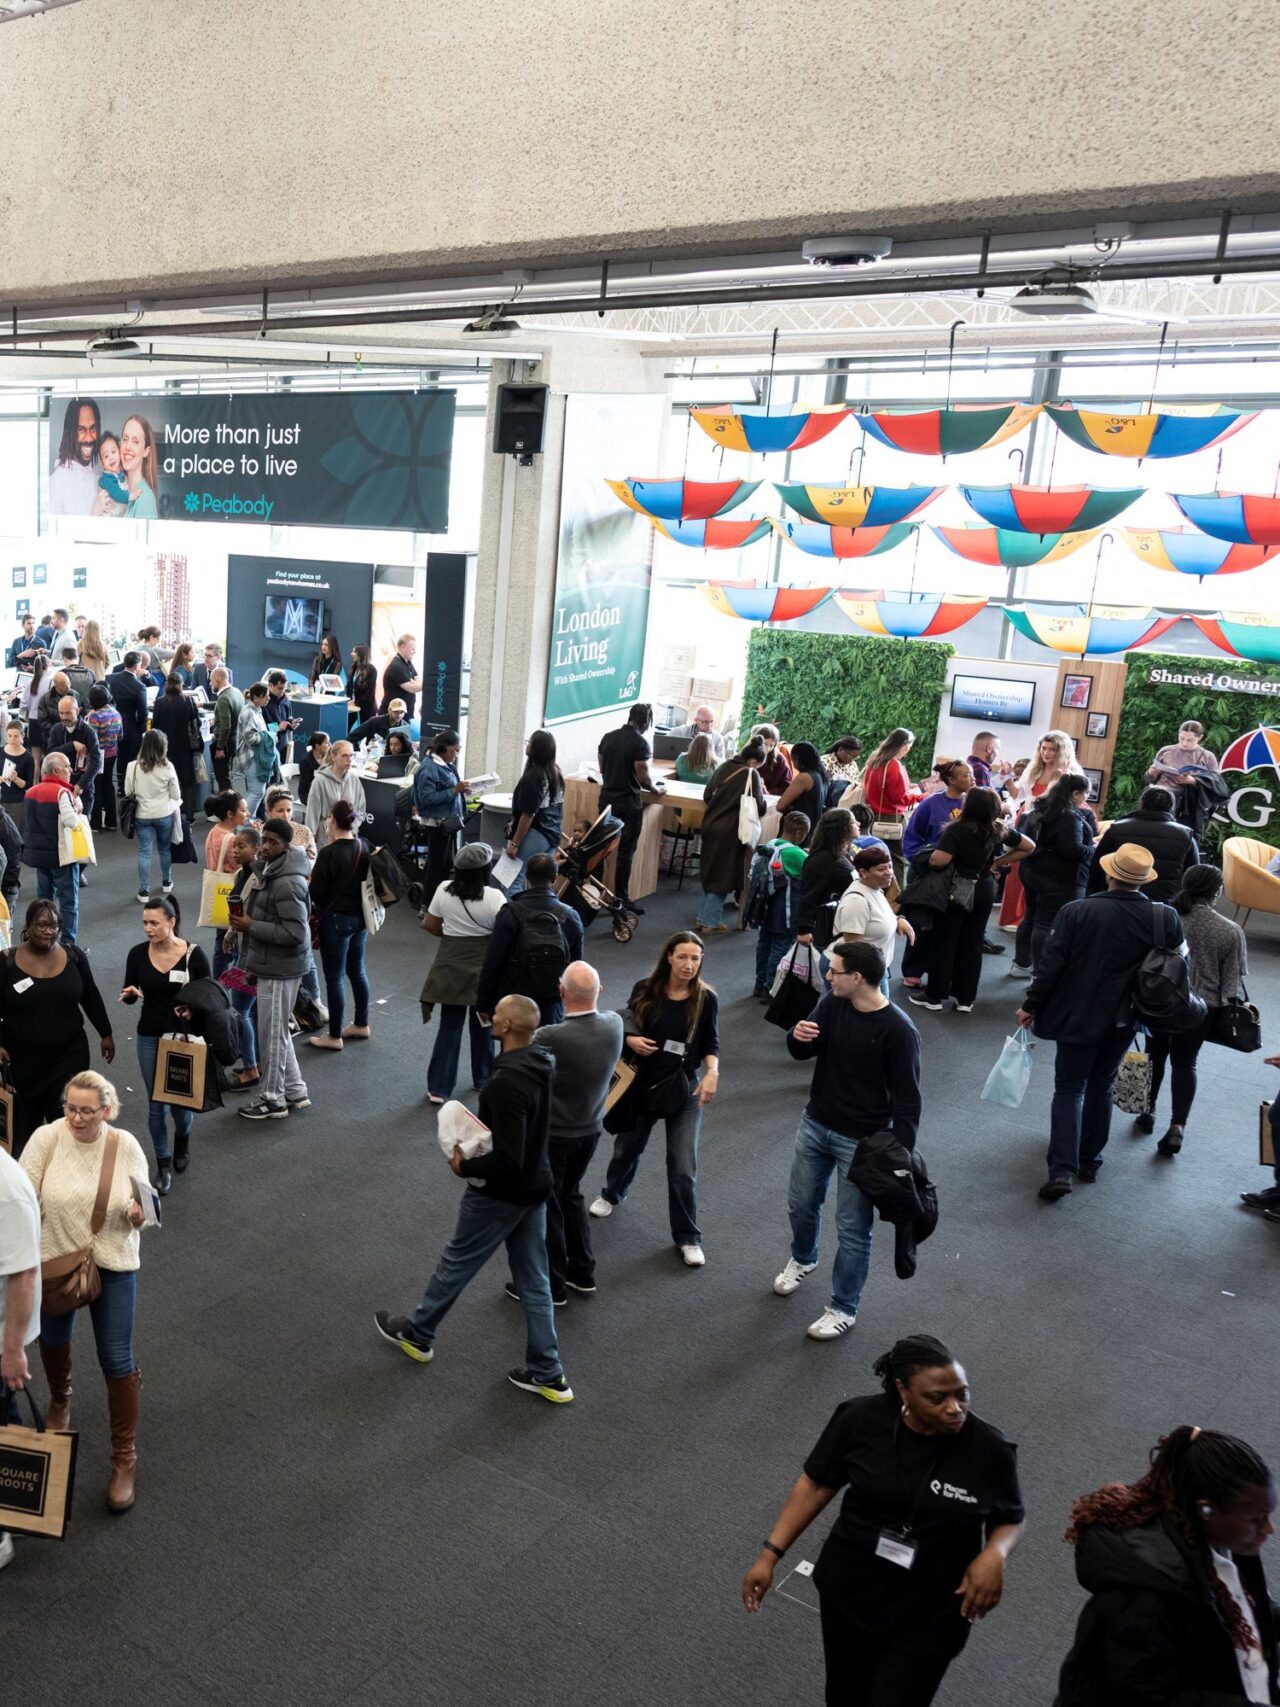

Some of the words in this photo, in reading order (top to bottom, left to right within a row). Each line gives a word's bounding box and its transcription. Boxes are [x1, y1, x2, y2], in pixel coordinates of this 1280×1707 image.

[164, 423, 210, 444] More
[215, 423, 260, 444] than
[264, 423, 301, 450] just
[163, 457, 175, 474] a
[181, 453, 235, 478] place
[240, 454, 259, 475] to
[265, 454, 298, 476] live
[202, 493, 274, 522] Peabody
[557, 601, 621, 634] London
[554, 636, 610, 667] Living
[554, 676, 568, 686] With
[568, 671, 587, 684] Shared
[587, 665, 616, 679] Ownership
[1150, 669, 1214, 688] Shared
[433, 673, 446, 715] Peabody
[962, 689, 985, 699] Shared
[986, 693, 1024, 703] Ownership
[974, 698, 999, 707] Homes
[943, 1490, 955, 1499] for
[954, 1493, 978, 1504] People
[944, 1482, 968, 1495] Places
